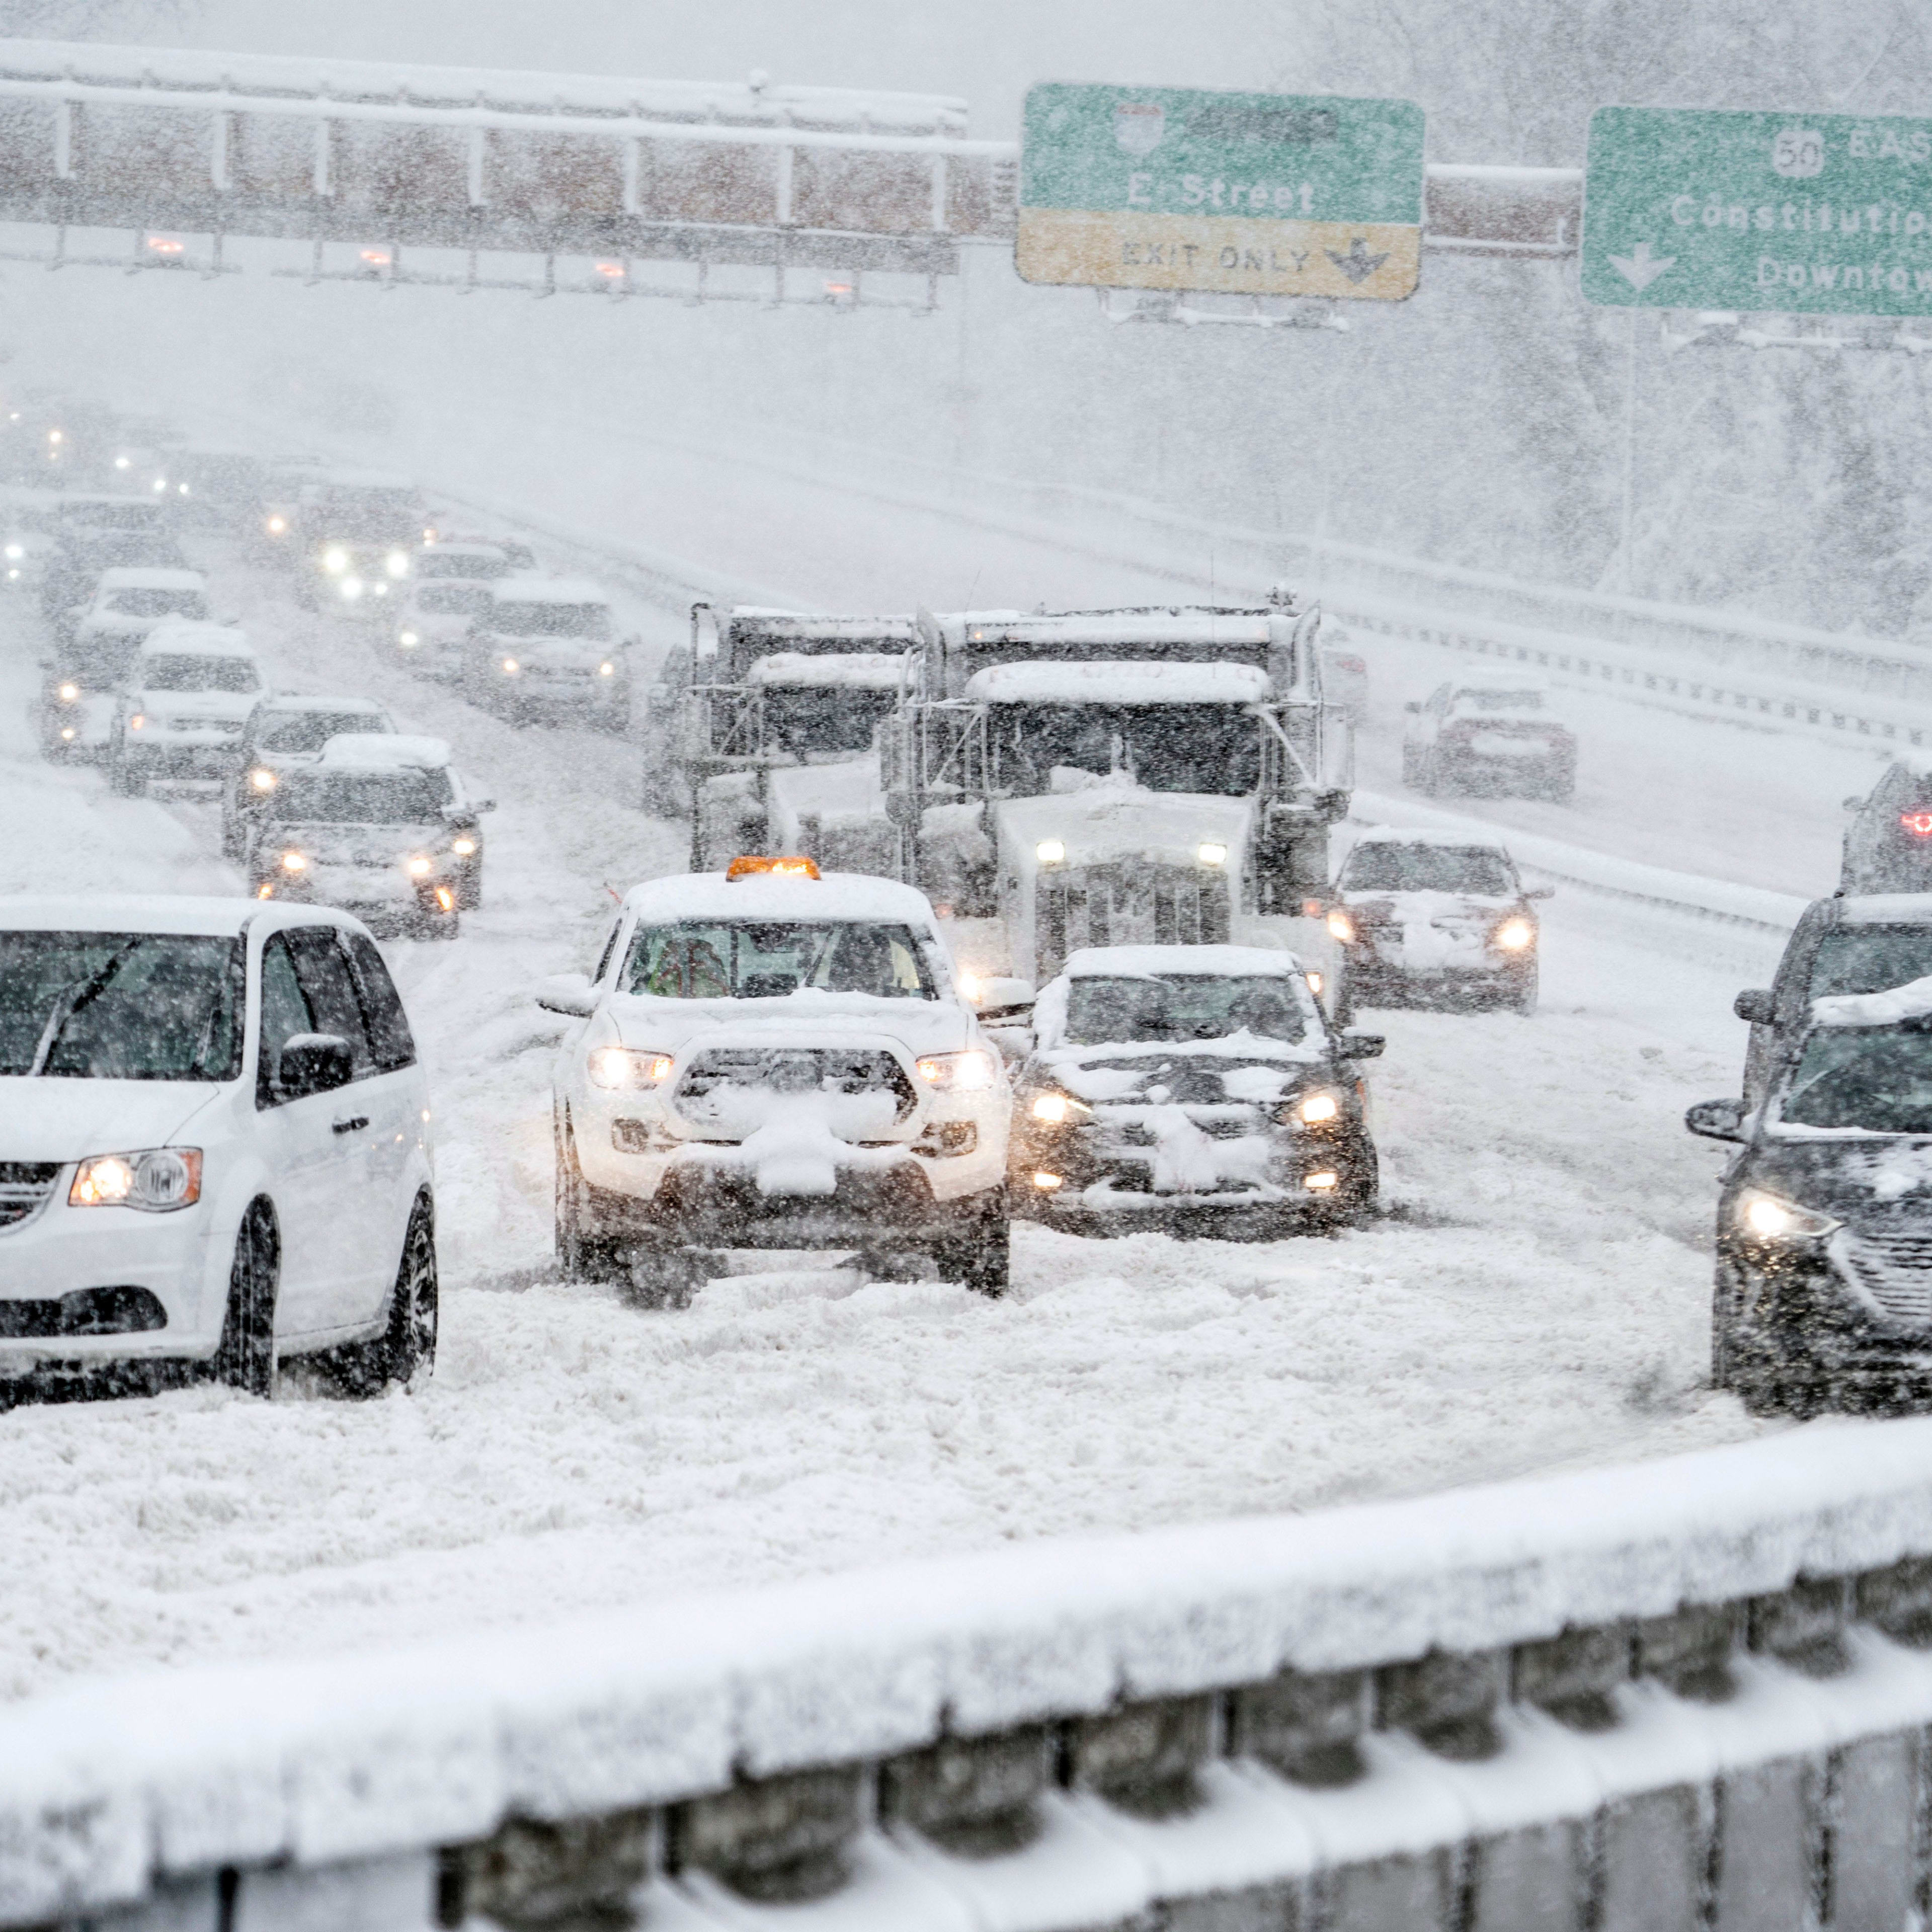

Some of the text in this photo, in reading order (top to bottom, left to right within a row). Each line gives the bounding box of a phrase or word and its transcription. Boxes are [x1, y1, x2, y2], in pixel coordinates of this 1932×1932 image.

[1778, 138, 1820, 169] 50
[1129, 173, 1315, 212] E Street
[1122, 242, 1310, 273] EXIT ONLY
